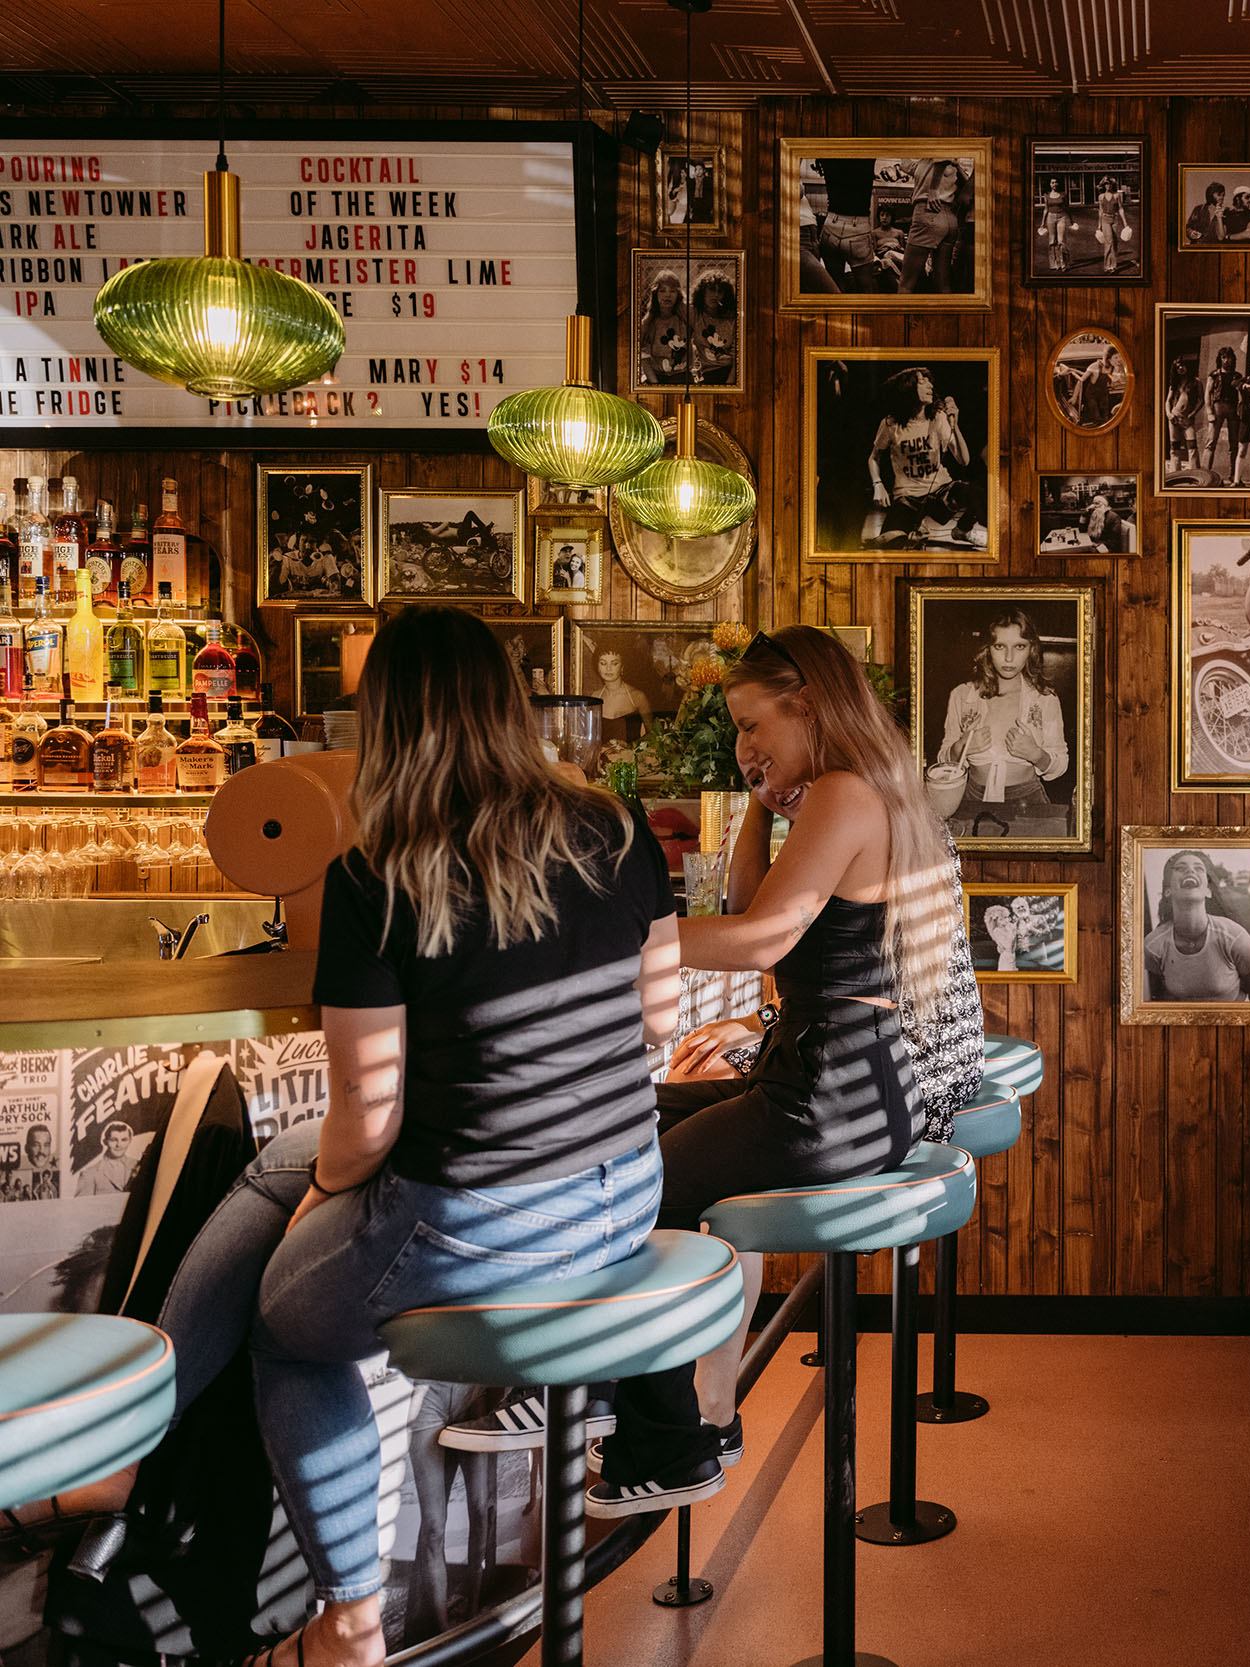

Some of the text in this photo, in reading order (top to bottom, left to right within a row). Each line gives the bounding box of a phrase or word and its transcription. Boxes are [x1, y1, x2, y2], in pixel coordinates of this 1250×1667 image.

[301, 157, 419, 183] COCKTAIL
[28, 191, 186, 216] NEWTOWNER
[290, 191, 457, 217] OF THE WEEK
[54, 224, 97, 249] ALE
[305, 225, 426, 250] JAGERITA
[448, 260, 511, 285] LIME
[15, 291, 56, 316] IPA
[392, 292, 435, 318] $19
[16, 358, 125, 382] A TINNIE
[369, 359, 504, 383] MARY $14
[36, 391, 122, 415] FRIDGE
[421, 392, 481, 417] YES!
[901, 435, 932, 453] FUCK
[904, 464, 939, 478] CLOCK
[907, 452, 931, 465] THE
[20, 1056, 57, 1074] BERRY
[77, 1045, 149, 1102] CHARLIE
[24, 1075, 47, 1084] TRIO
[254, 1069, 331, 1112] LITTL
[2, 1102, 47, 1114] ARTHUR
